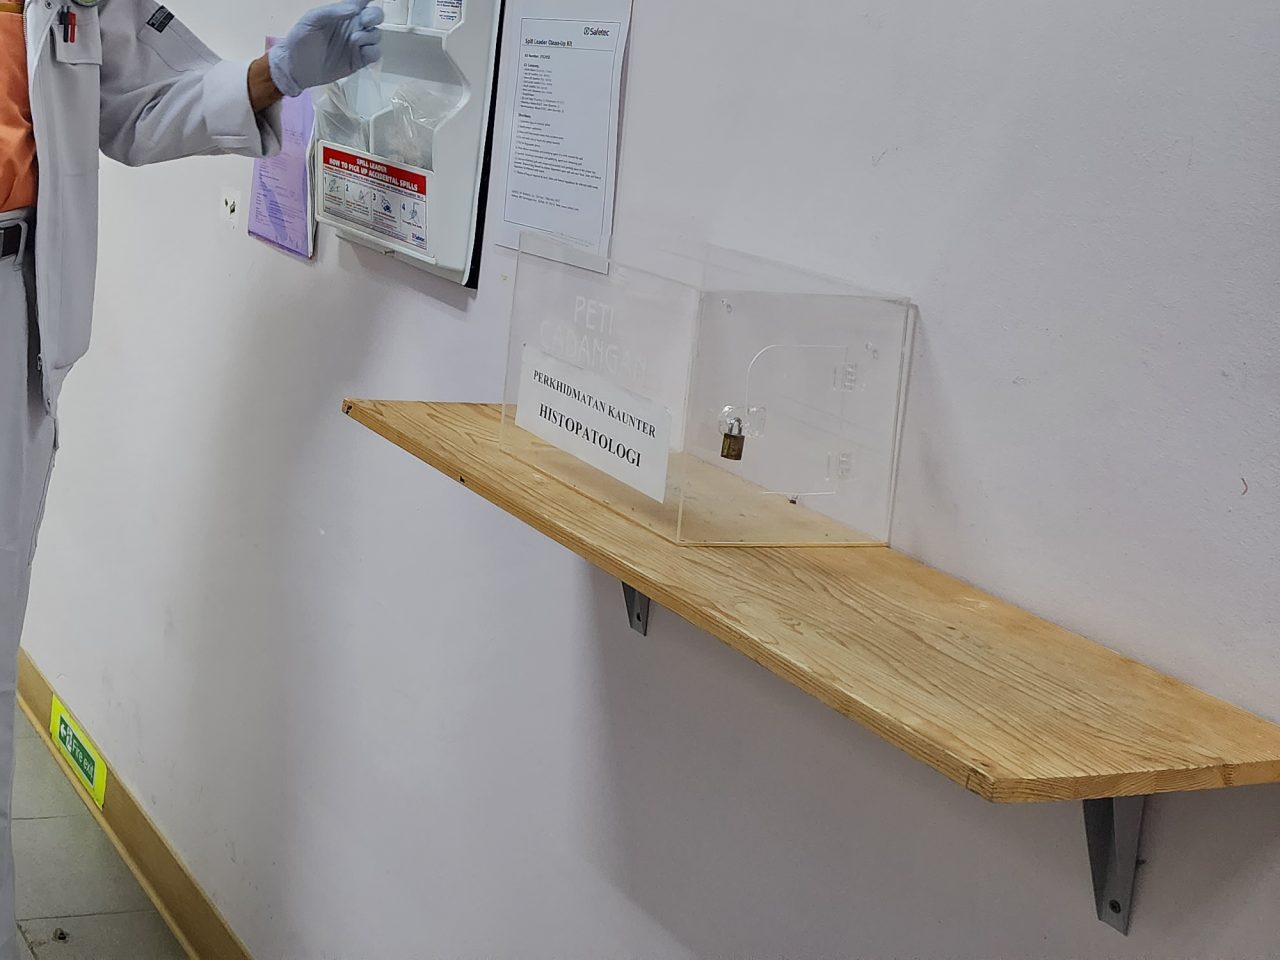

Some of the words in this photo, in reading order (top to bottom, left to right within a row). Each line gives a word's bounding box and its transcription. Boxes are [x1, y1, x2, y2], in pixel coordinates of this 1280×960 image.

[590, 27, 610, 37] Safetec
[329, 157, 340, 167] HOW
[341, 161, 348, 169] TO
[349, 164, 360, 173] PICK
[361, 167, 368, 175] UP
[369, 169, 399, 186] ACCIDENTAL
[400, 180, 418, 191] SPILLS
[574, 295, 614, 336] PETI
[533, 369, 606, 414] PERKHIDMATAN
[608, 405, 656, 439] KAUNTER
[539, 403, 641, 468] HISTOPATOLOGI
